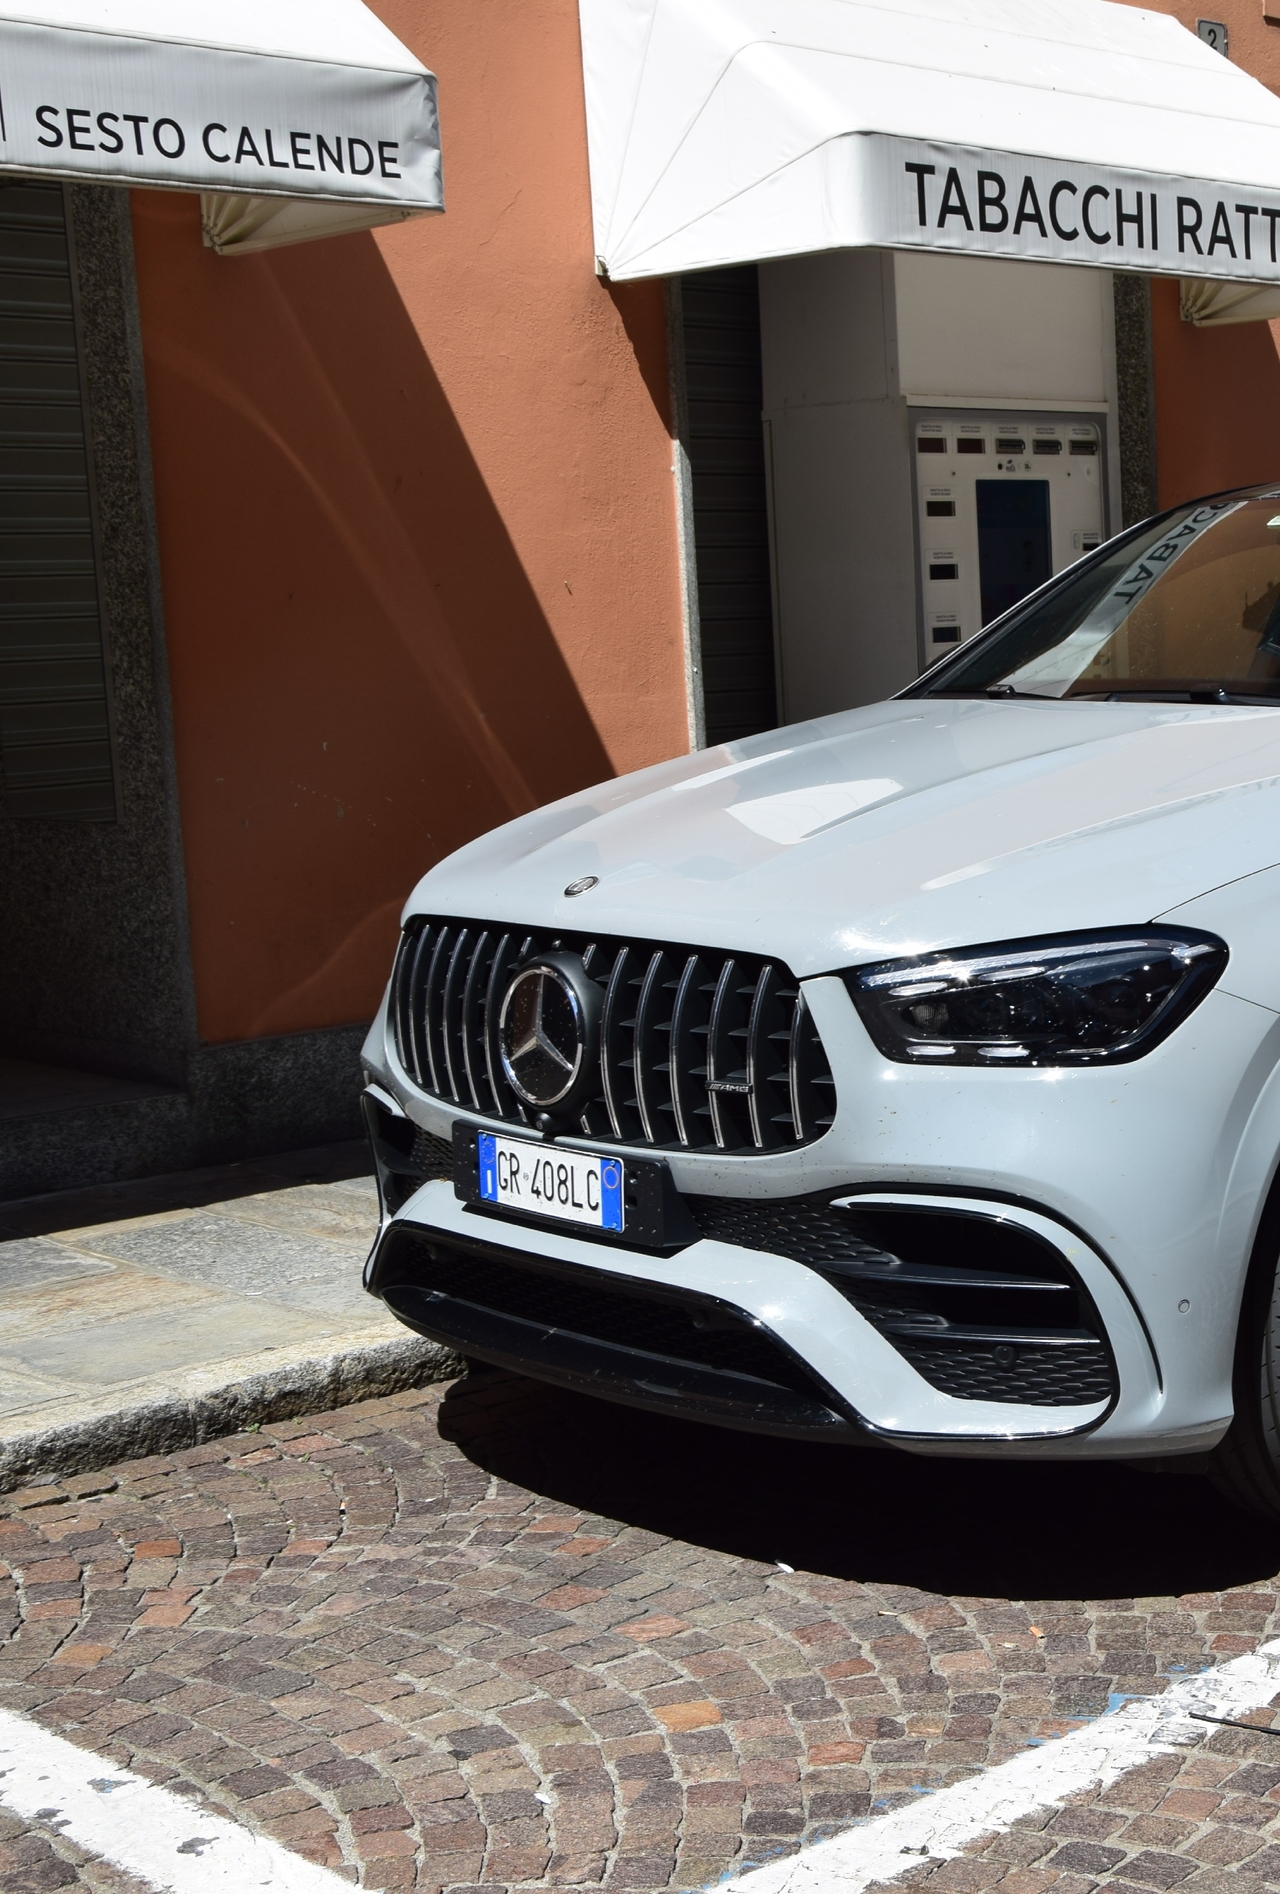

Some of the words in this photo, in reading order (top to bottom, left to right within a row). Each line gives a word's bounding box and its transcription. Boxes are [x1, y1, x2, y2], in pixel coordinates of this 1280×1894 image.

[1207, 28, 1218, 51] 2
[35, 105, 186, 159] SESTO
[202, 121, 402, 179] CALENDE
[904, 161, 1159, 252] TABACCHI
[497, 1150, 521, 1194] GR
[531, 1158, 600, 1211] 408LC
